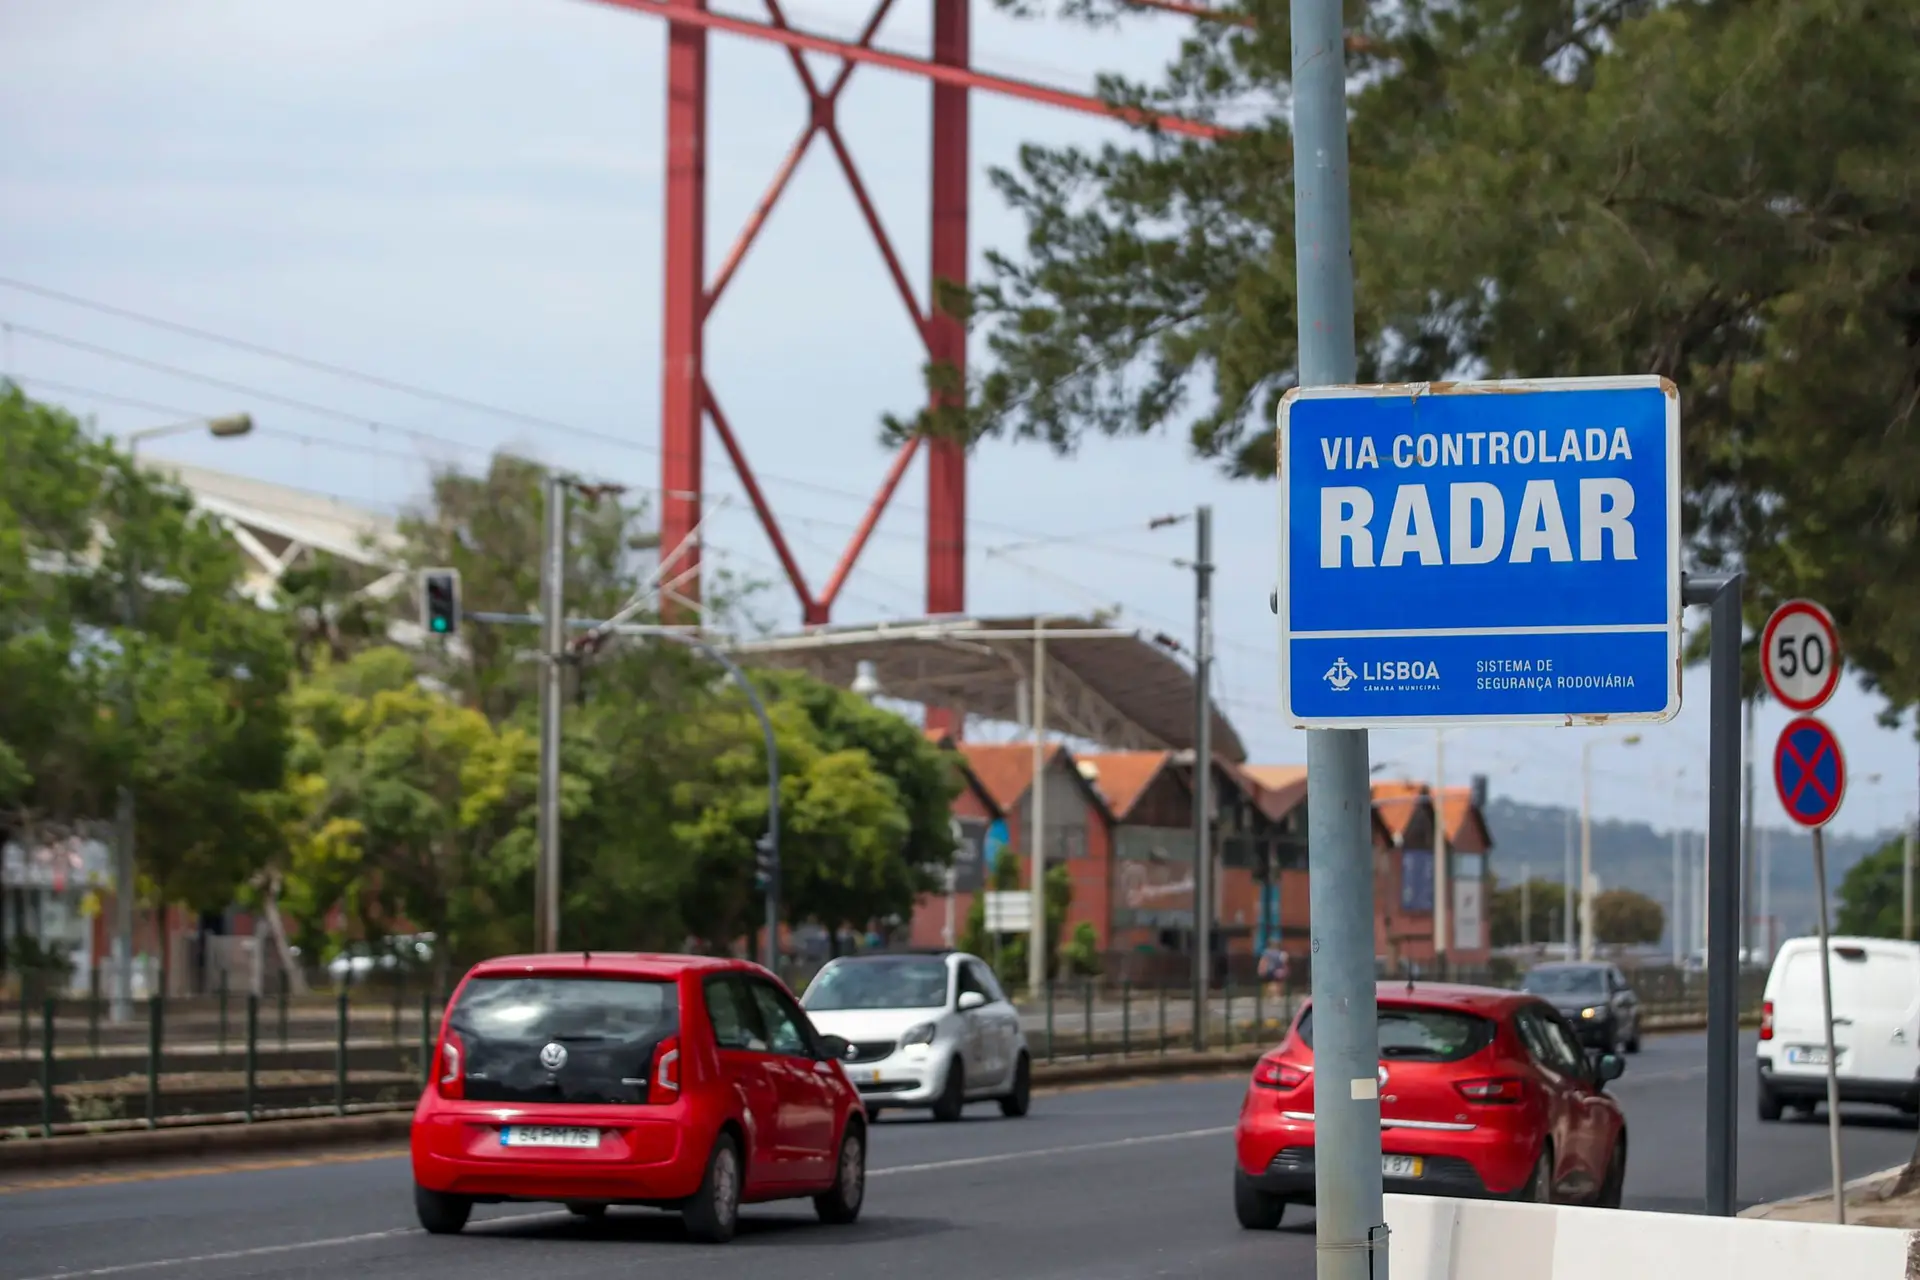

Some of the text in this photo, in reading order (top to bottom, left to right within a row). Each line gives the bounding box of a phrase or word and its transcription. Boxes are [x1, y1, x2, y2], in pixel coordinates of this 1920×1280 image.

[1320, 427, 1633, 470] VIA CONTROLADA
[1320, 477, 1638, 568] RADAR
[1476, 659, 1553, 673] SISTEMA DE
[1778, 633, 1824, 678] 50
[1363, 660, 1440, 681] LISBOA
[1363, 684, 1440, 692] CÂMARA MUNICIPAL
[1476, 674, 1635, 692] SEGURANÇA RODOVIÁRIA
